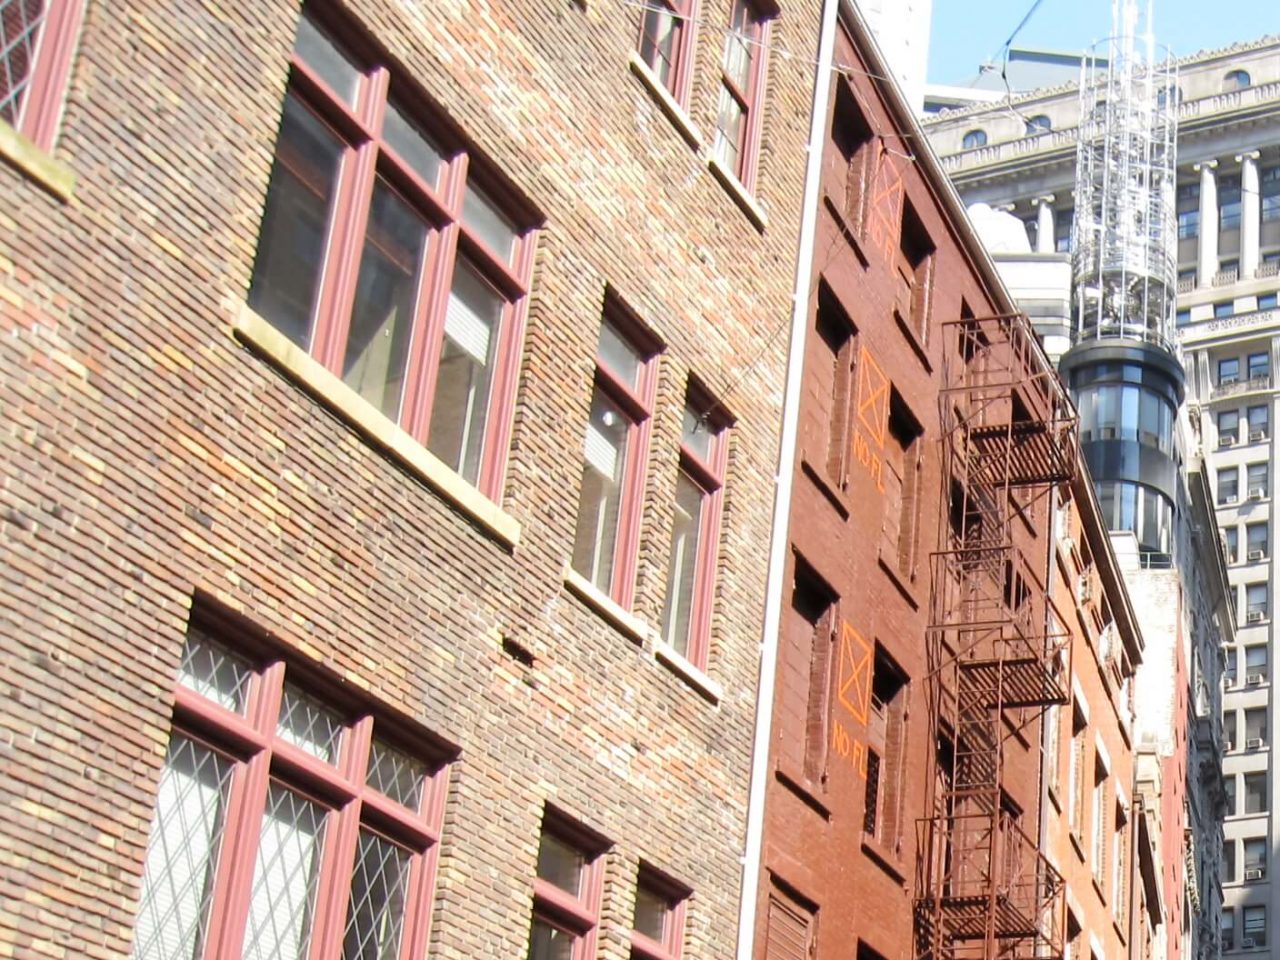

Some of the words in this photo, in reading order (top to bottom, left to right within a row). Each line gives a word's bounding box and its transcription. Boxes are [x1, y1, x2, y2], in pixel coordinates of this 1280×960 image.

[853, 429, 870, 466] NO
[871, 452, 885, 495] FL
[832, 720, 849, 757] NO
[852, 739, 867, 778] FL
